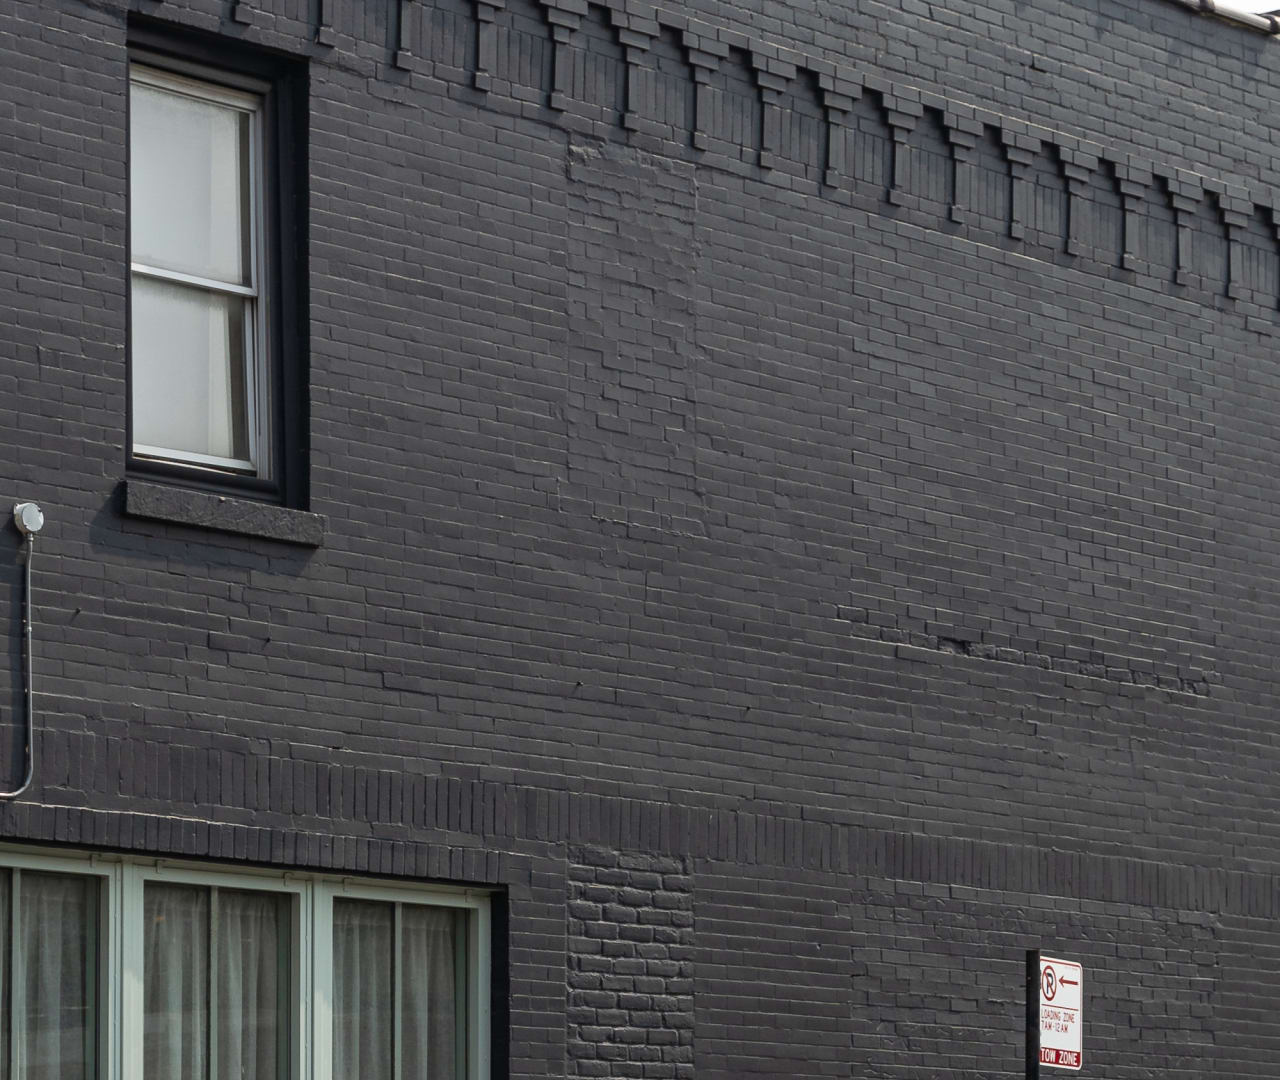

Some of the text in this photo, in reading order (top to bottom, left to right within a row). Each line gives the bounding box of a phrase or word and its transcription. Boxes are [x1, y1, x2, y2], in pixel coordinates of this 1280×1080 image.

[1041, 1009, 1075, 1024] LOADING ZONE
[1040, 1048, 1078, 1066] TOW ZONE
